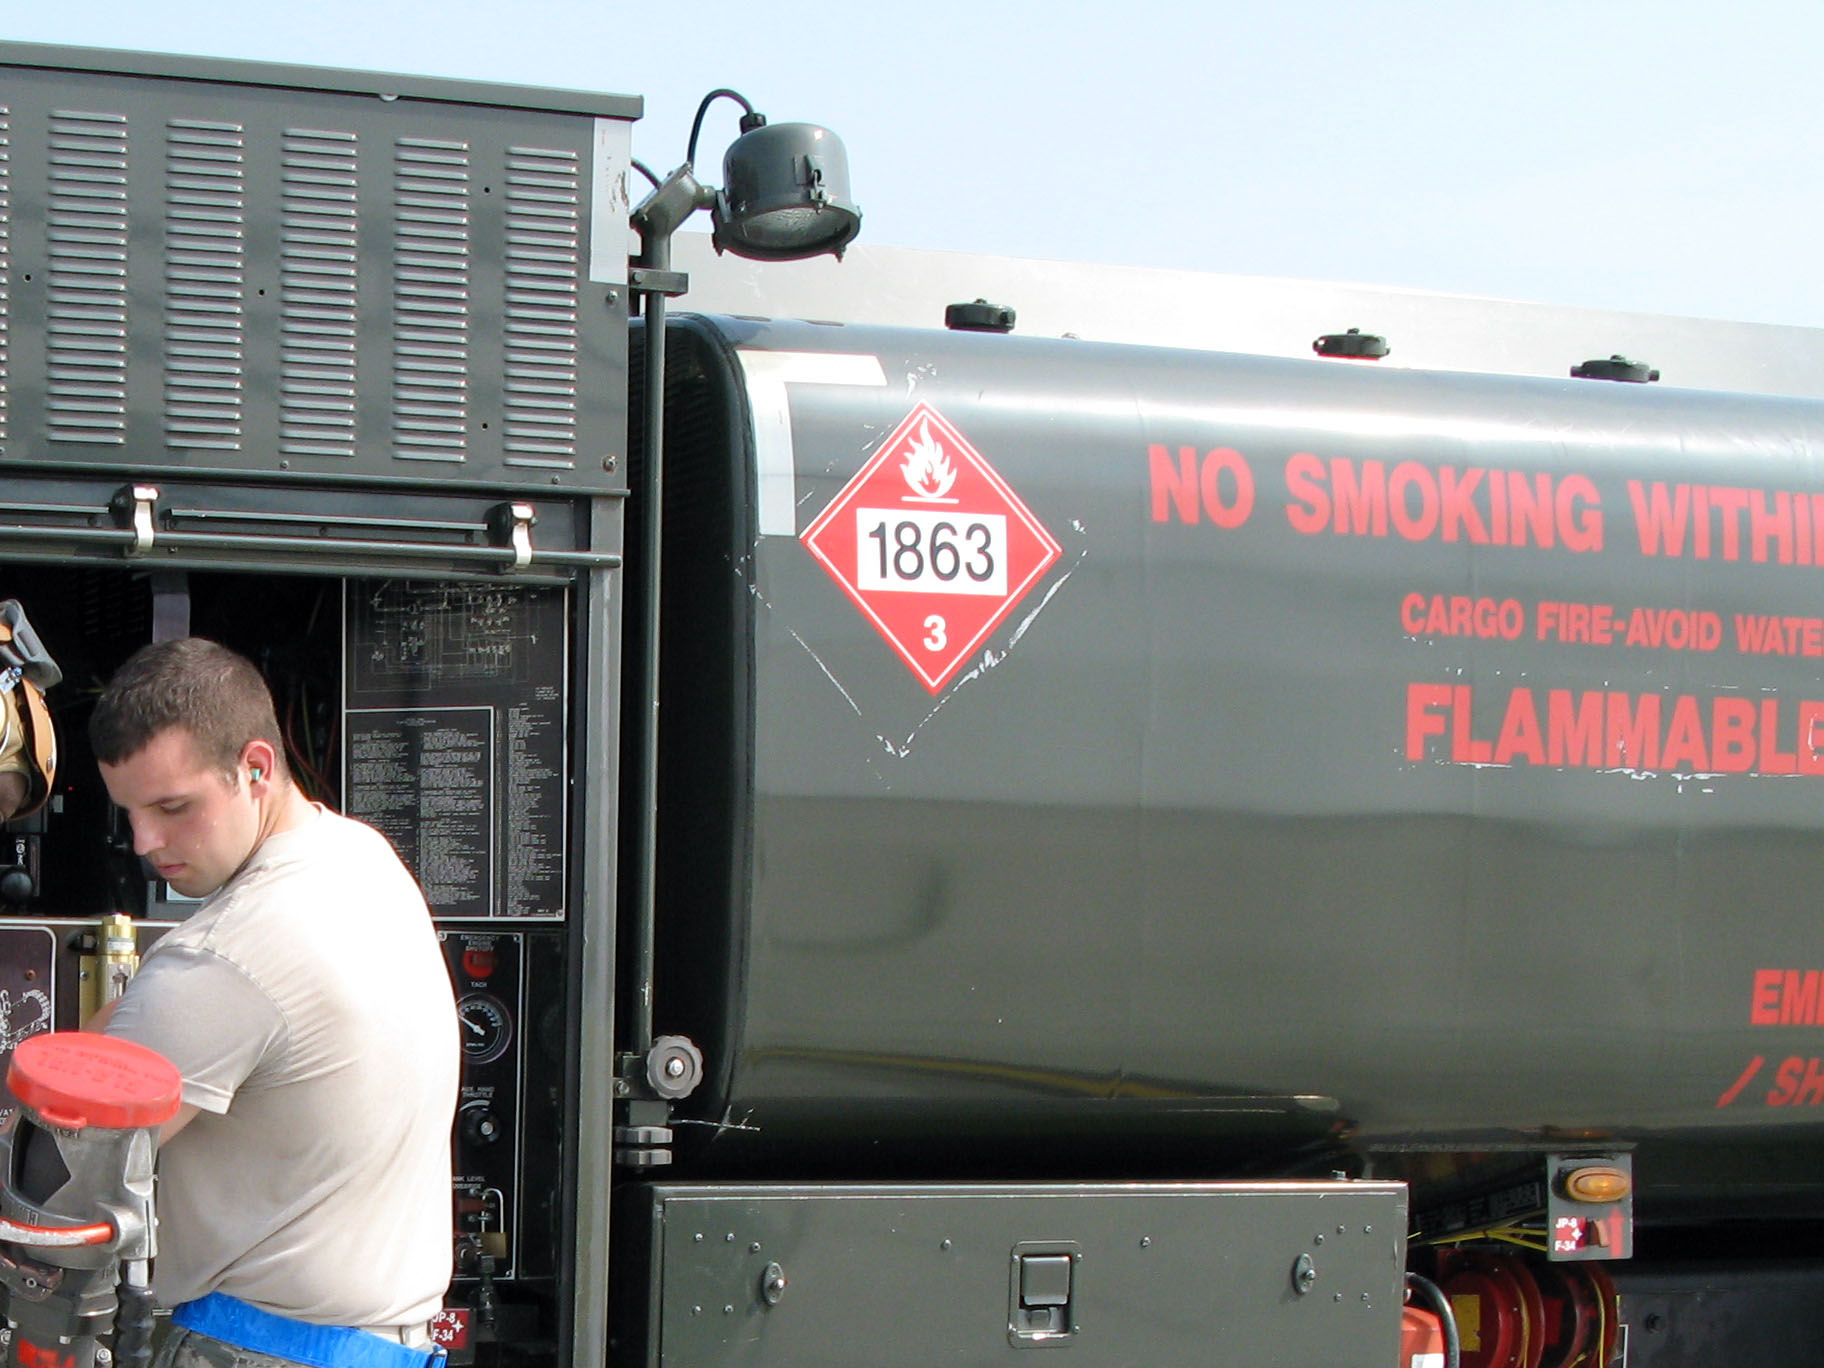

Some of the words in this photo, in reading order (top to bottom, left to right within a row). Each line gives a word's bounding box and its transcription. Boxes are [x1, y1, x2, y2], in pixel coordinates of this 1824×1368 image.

[1147, 443, 1255, 529] NO
[1284, 452, 1603, 553] SMOKING
[1627, 479, 1824, 568] WITHI
[868, 520, 995, 582] 1863
[923, 614, 948, 652] 3
[1401, 591, 1524, 640] CARGO
[1536, 601, 1722, 651] FIRE-AVOID
[1734, 613, 1824, 657] WATE
[1405, 682, 1824, 777] FLAMMABLE
[1749, 968, 1824, 1026] EM
[1554, 1239, 1577, 1252] F-34
[1555, 1216, 1578, 1229] JP-8
[432, 1311, 456, 1324] JP-8
[432, 1328, 454, 1342] F-34
